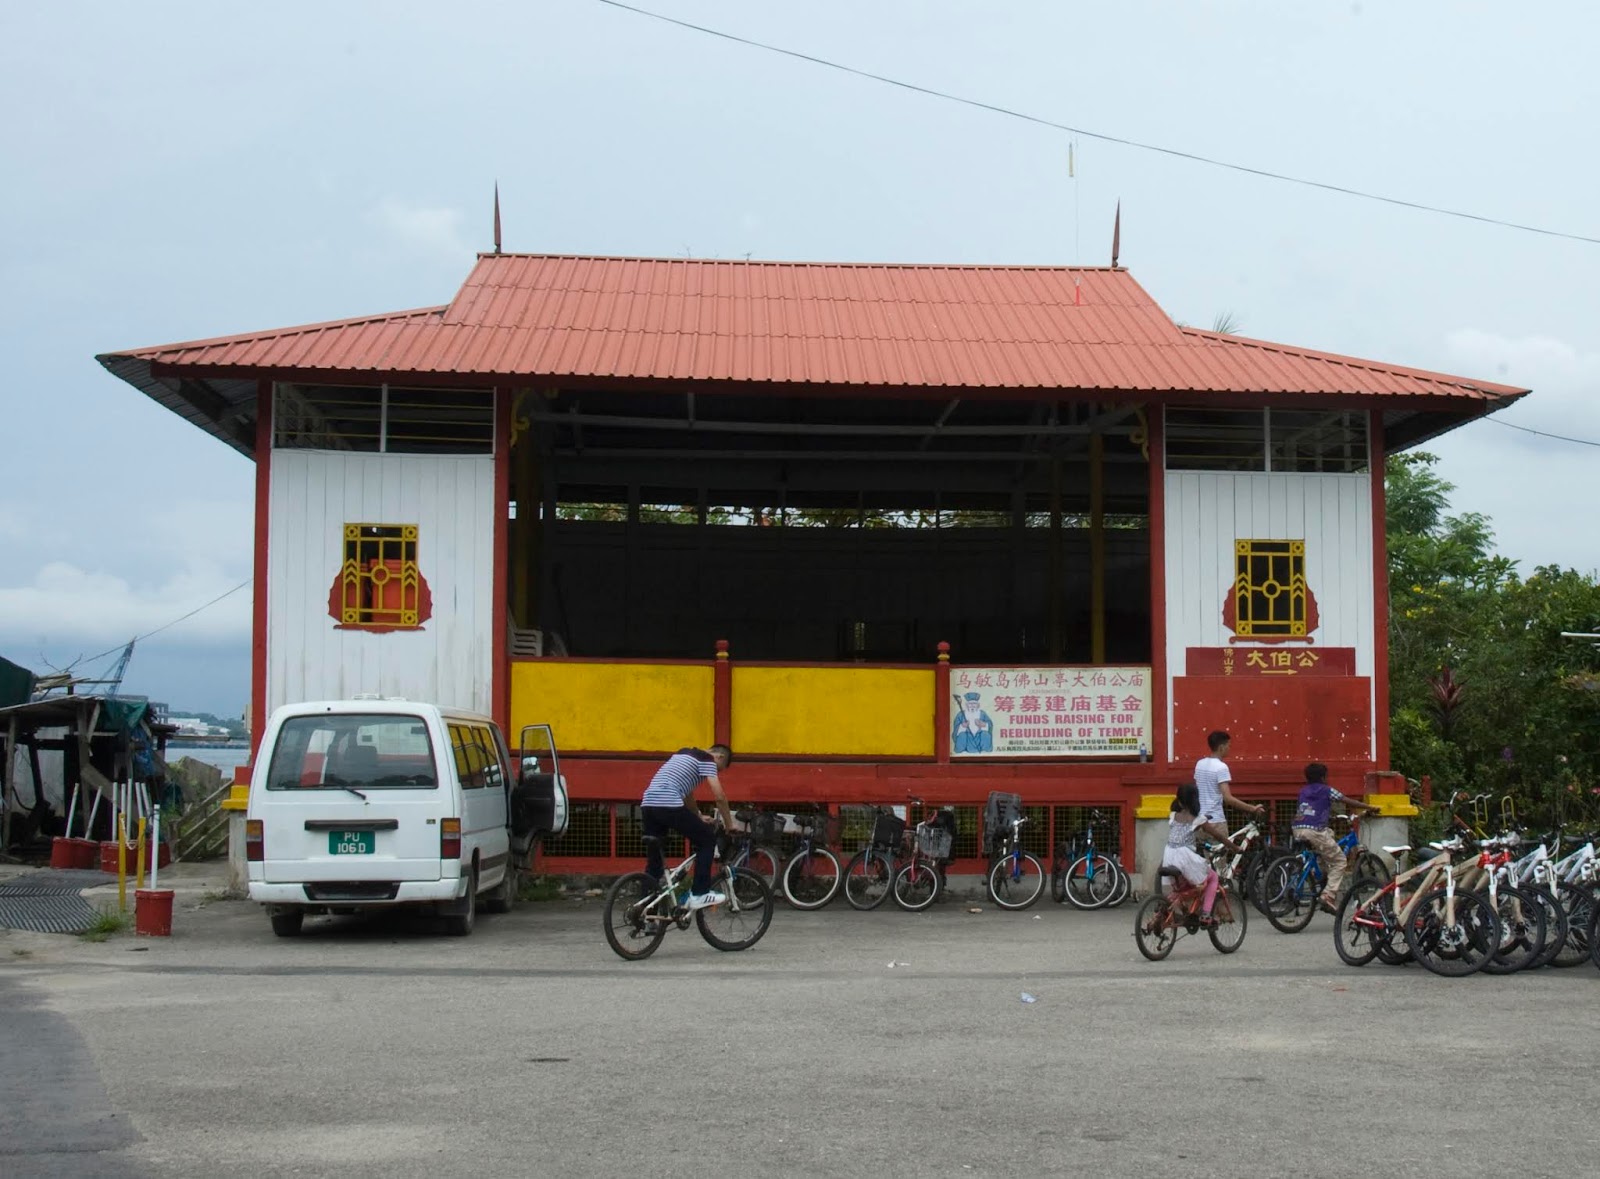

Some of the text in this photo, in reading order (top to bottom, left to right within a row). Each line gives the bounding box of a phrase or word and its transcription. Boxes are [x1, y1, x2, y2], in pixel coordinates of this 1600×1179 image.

[1246, 650, 1319, 668] 大伯公
[956, 671, 1144, 689] 乌敏岛佛山亭大伯公庙
[994, 695, 1143, 712] 筹募建庙基金
[1009, 714, 1134, 724] FUNDS RAISING FOR
[1000, 727, 1144, 738] REBUILDING OF TEMPLE
[344, 832, 360, 842] PU
